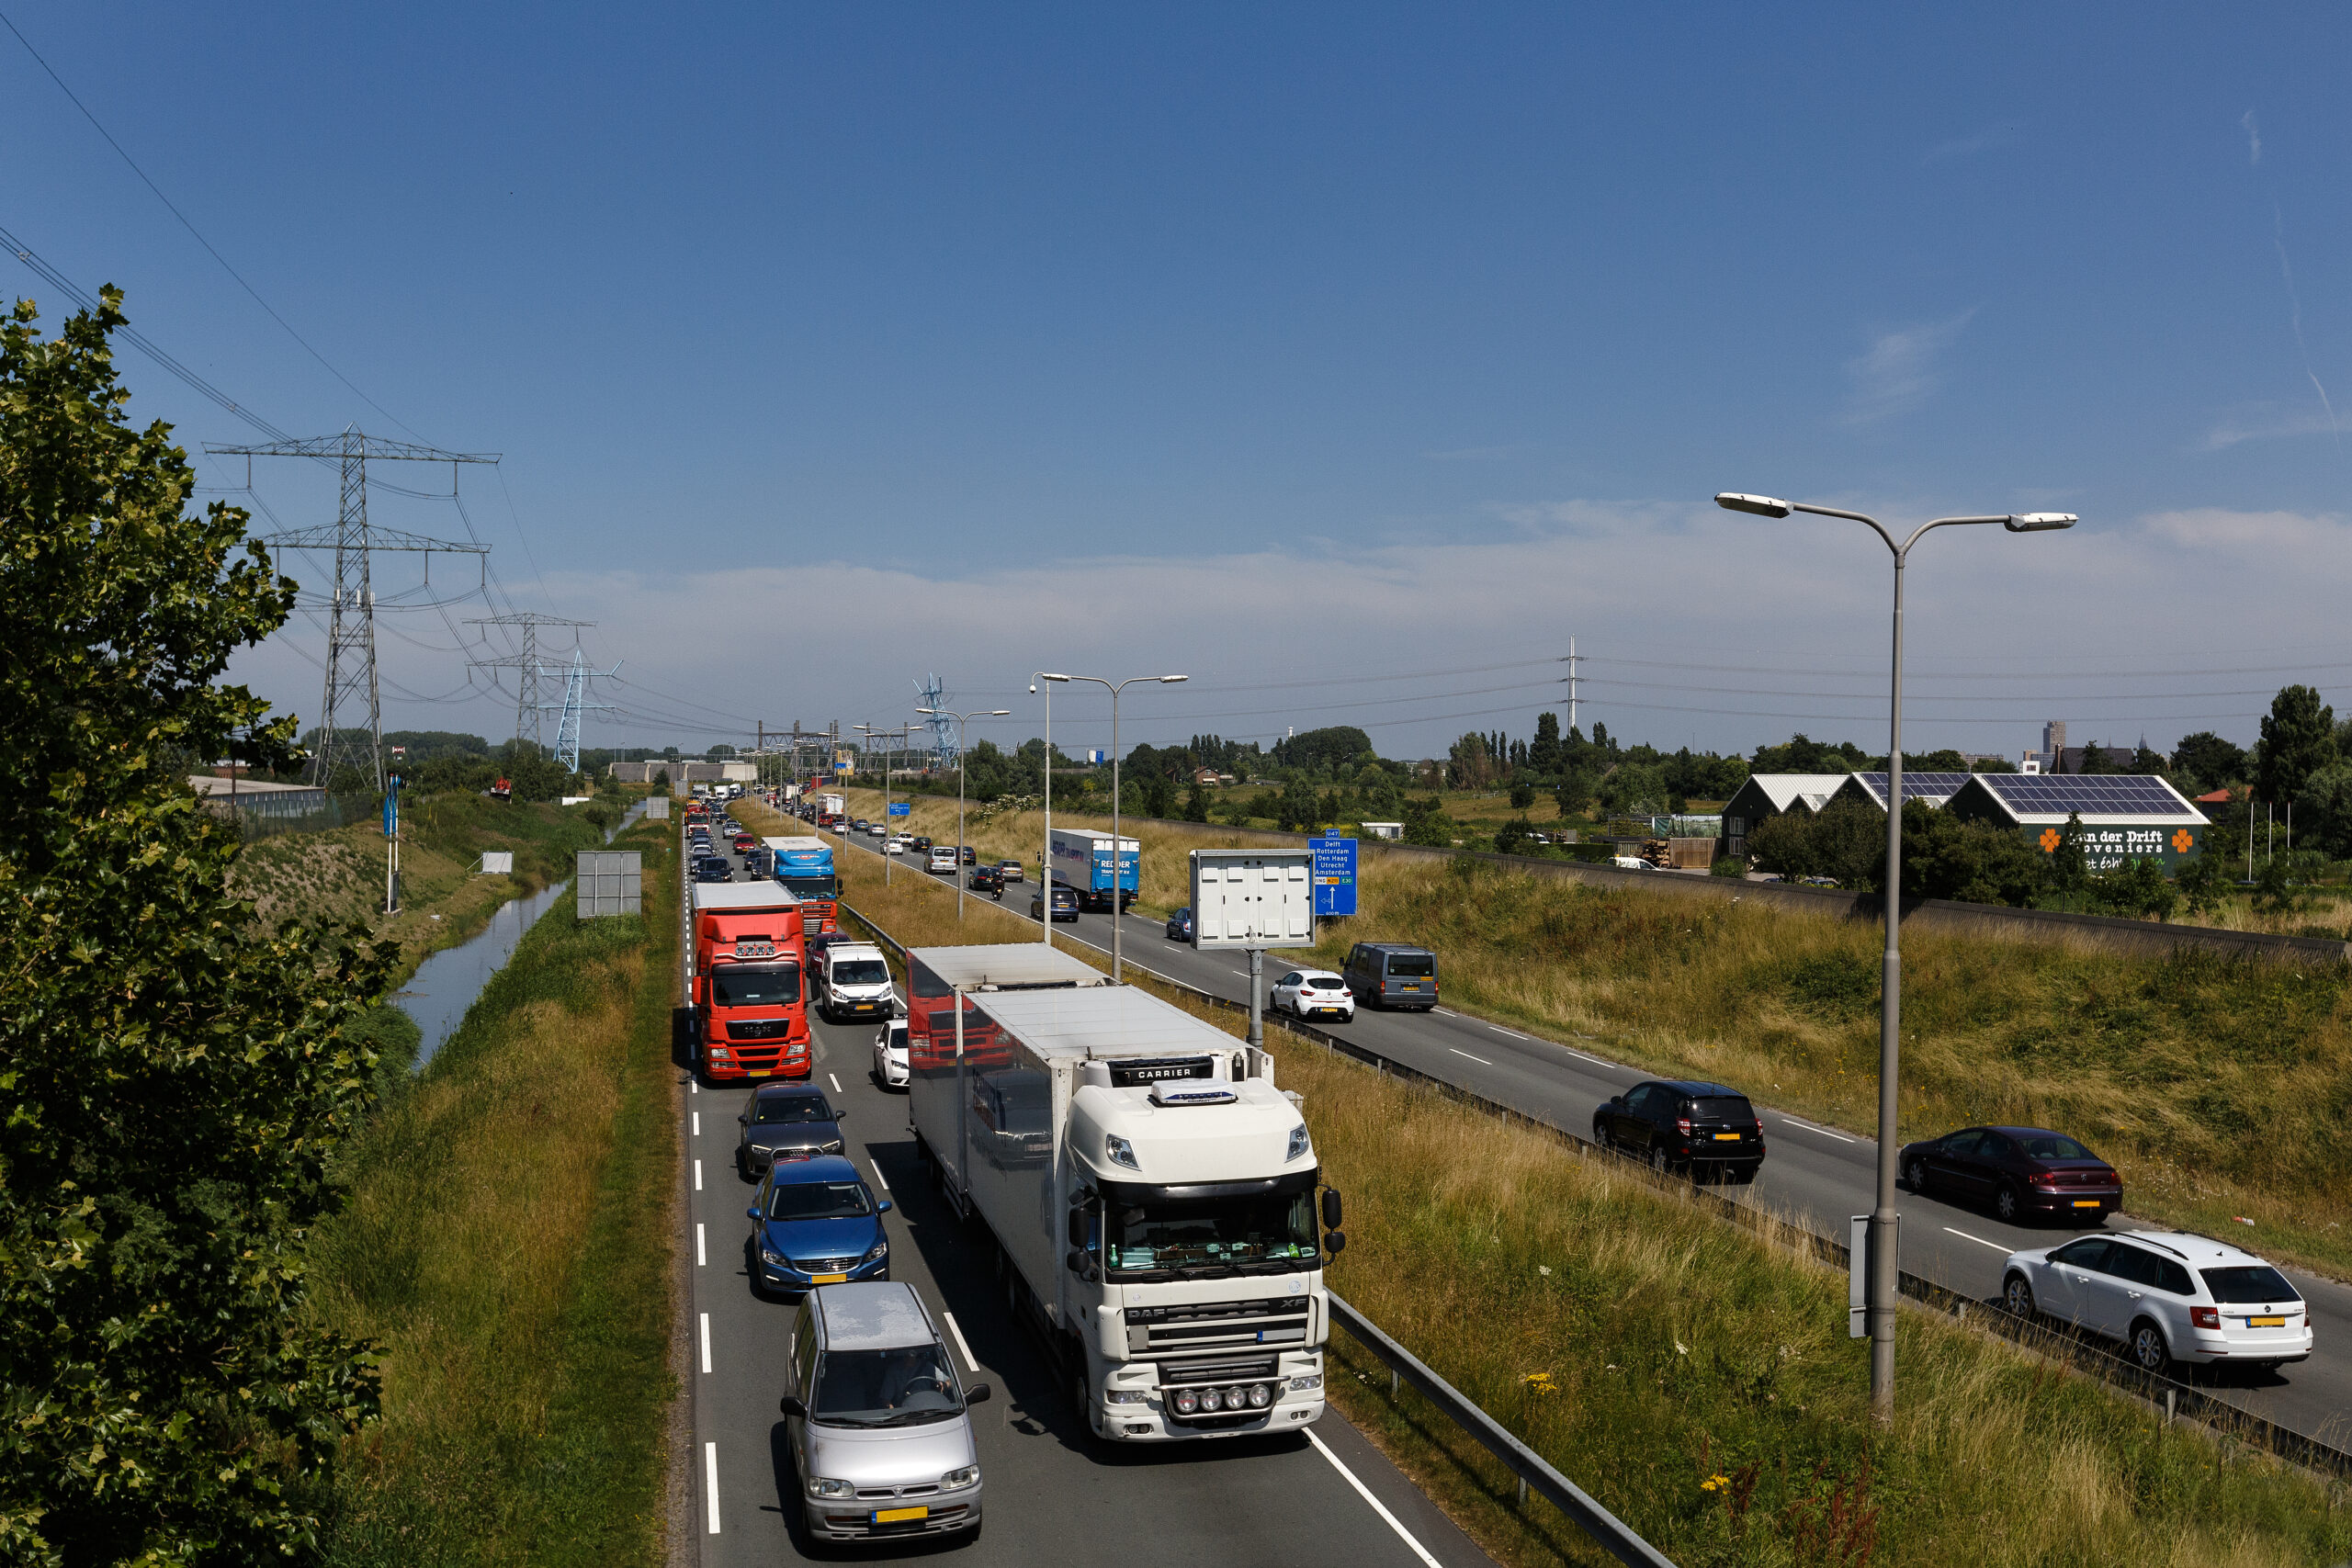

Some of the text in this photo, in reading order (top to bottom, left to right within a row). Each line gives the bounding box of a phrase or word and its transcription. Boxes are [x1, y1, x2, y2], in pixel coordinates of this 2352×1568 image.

[2099, 830, 2122, 842] der
[2126, 830, 2163, 842] Drift
[2071, 842, 2163, 853] oveniers
[1138, 1069, 1191, 1078] CARRIER
[1127, 1298, 1306, 1318] DAF XF
